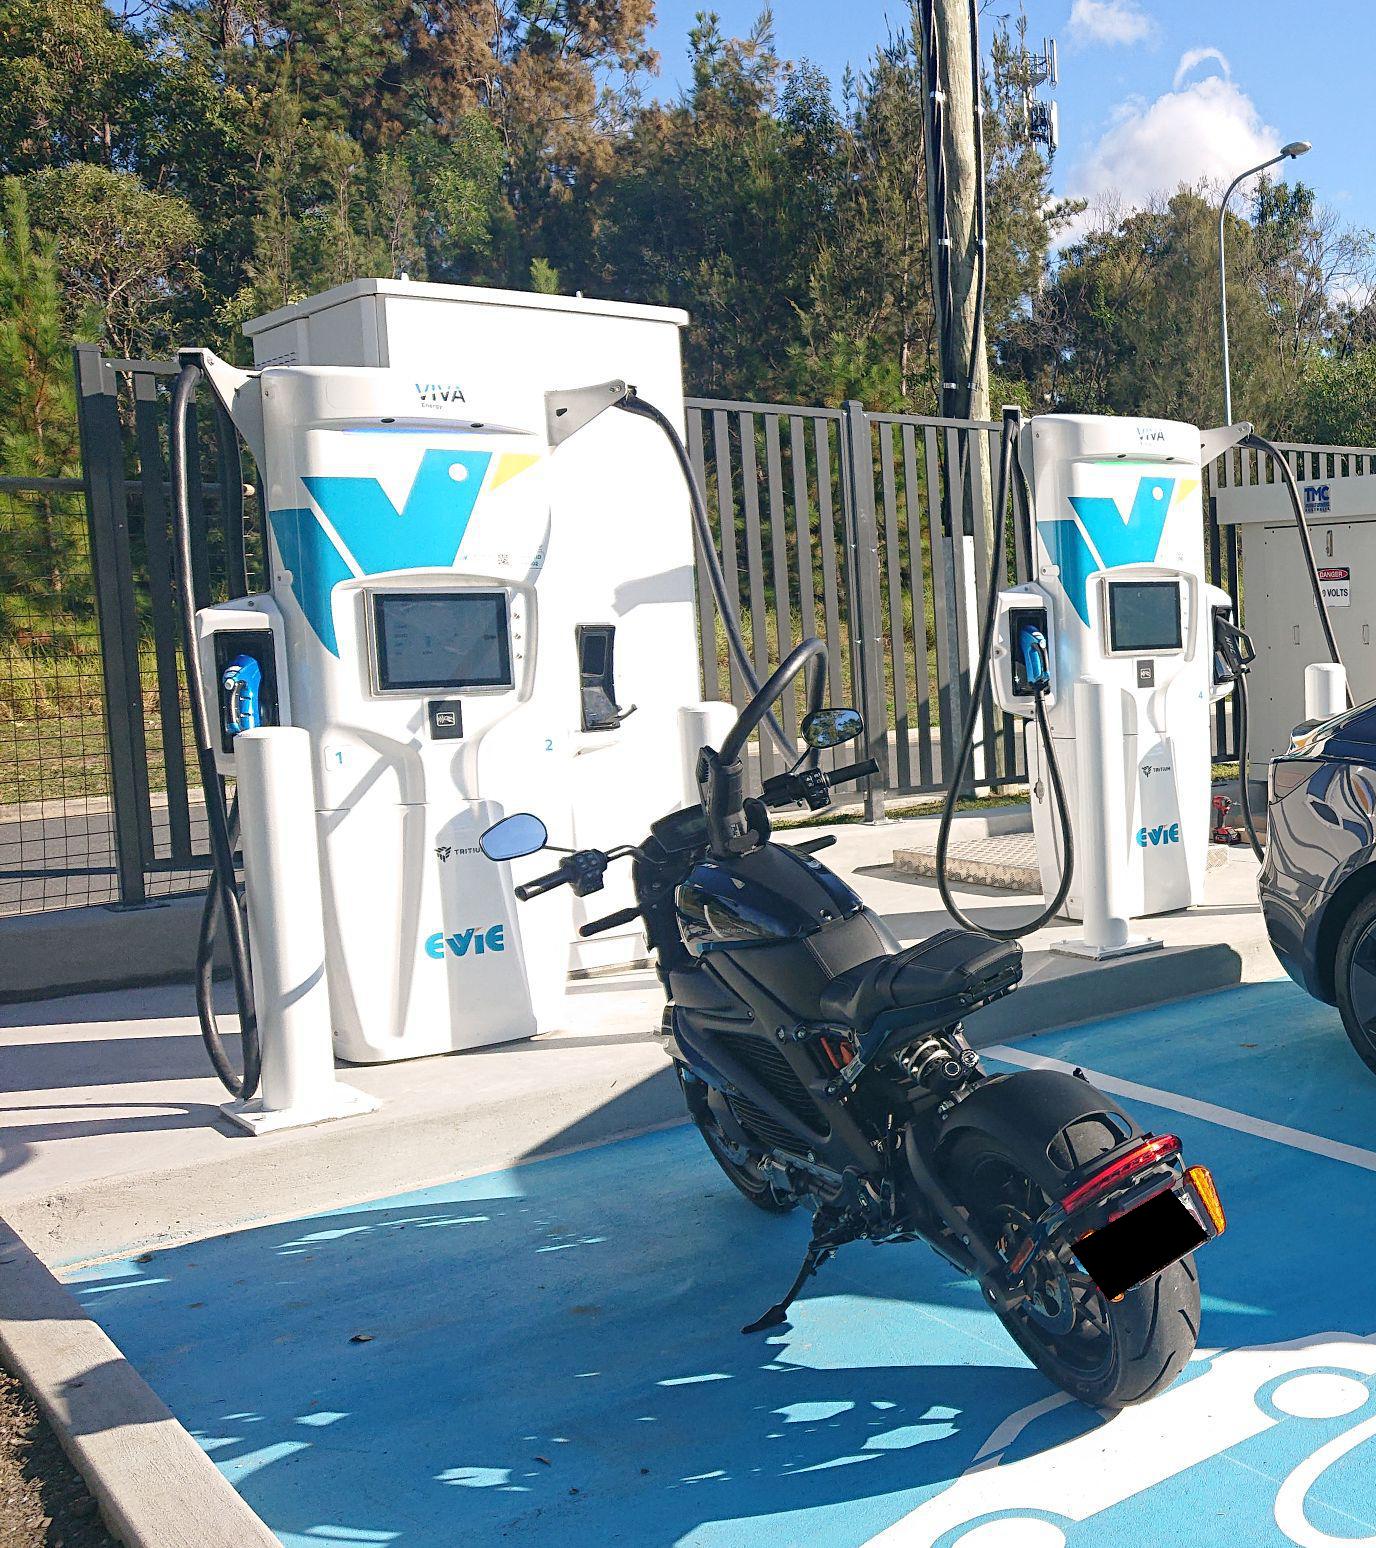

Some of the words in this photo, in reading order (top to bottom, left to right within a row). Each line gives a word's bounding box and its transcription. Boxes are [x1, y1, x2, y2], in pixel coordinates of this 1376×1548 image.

[415, 383, 466, 403] VIVA
[1137, 427, 1165, 441] VIVA
[1304, 485, 1330, 502] TMC
[1327, 588, 1349, 597] VOLTS
[545, 739, 553, 751] 2
[335, 751, 344, 765] 1
[454, 848, 482, 856] TRITIU
